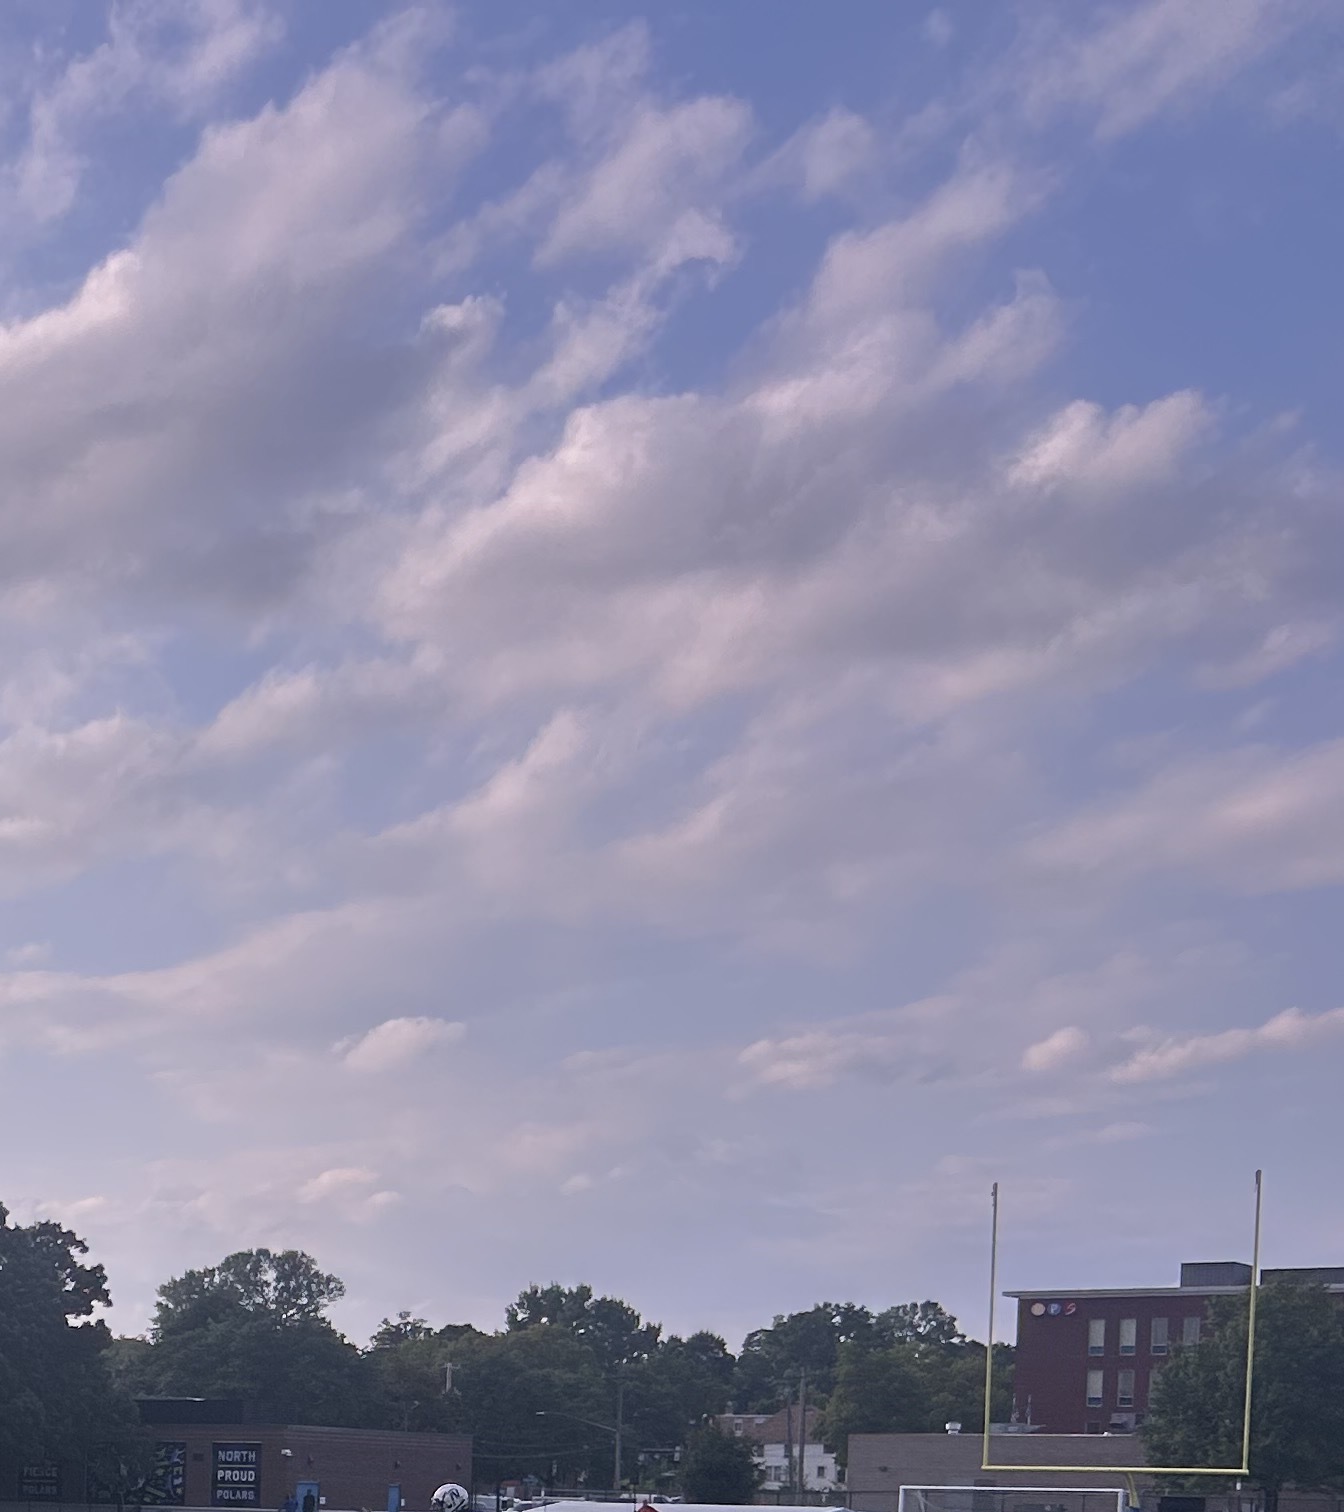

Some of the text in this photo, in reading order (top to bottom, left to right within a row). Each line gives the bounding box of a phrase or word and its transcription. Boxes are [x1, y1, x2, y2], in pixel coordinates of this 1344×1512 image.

[218, 1450, 256, 1462] NORTH
[217, 1470, 256, 1482] PROUD
[216, 1489, 255, 1500] POLARS
